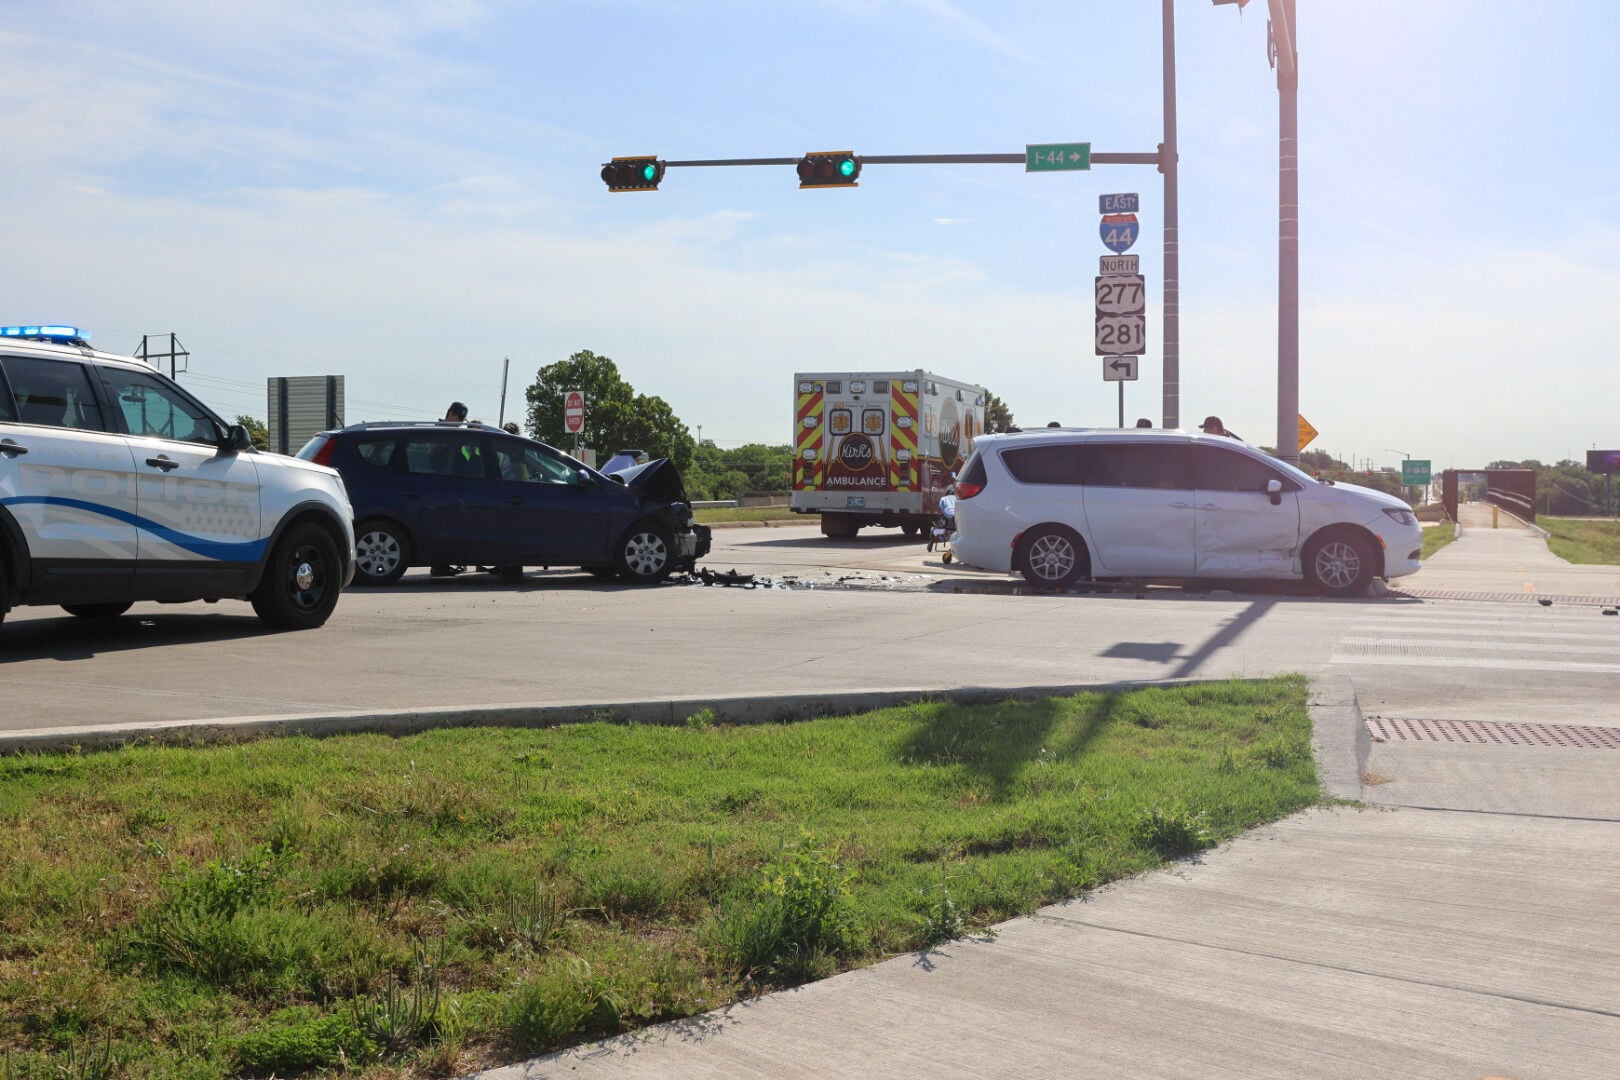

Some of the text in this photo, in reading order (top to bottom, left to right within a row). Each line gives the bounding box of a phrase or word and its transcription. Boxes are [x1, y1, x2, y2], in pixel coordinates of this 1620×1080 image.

[1035, 150, 1065, 165] I-44
[1105, 196, 1132, 210] EAST
[1105, 227, 1133, 247] 44
[1101, 259, 1138, 272] NORTH
[1098, 282, 1142, 304] 277
[1099, 323, 1142, 346] 281
[19, 463, 261, 505] POLICE
[826, 476, 887, 486] AMBULANCE
